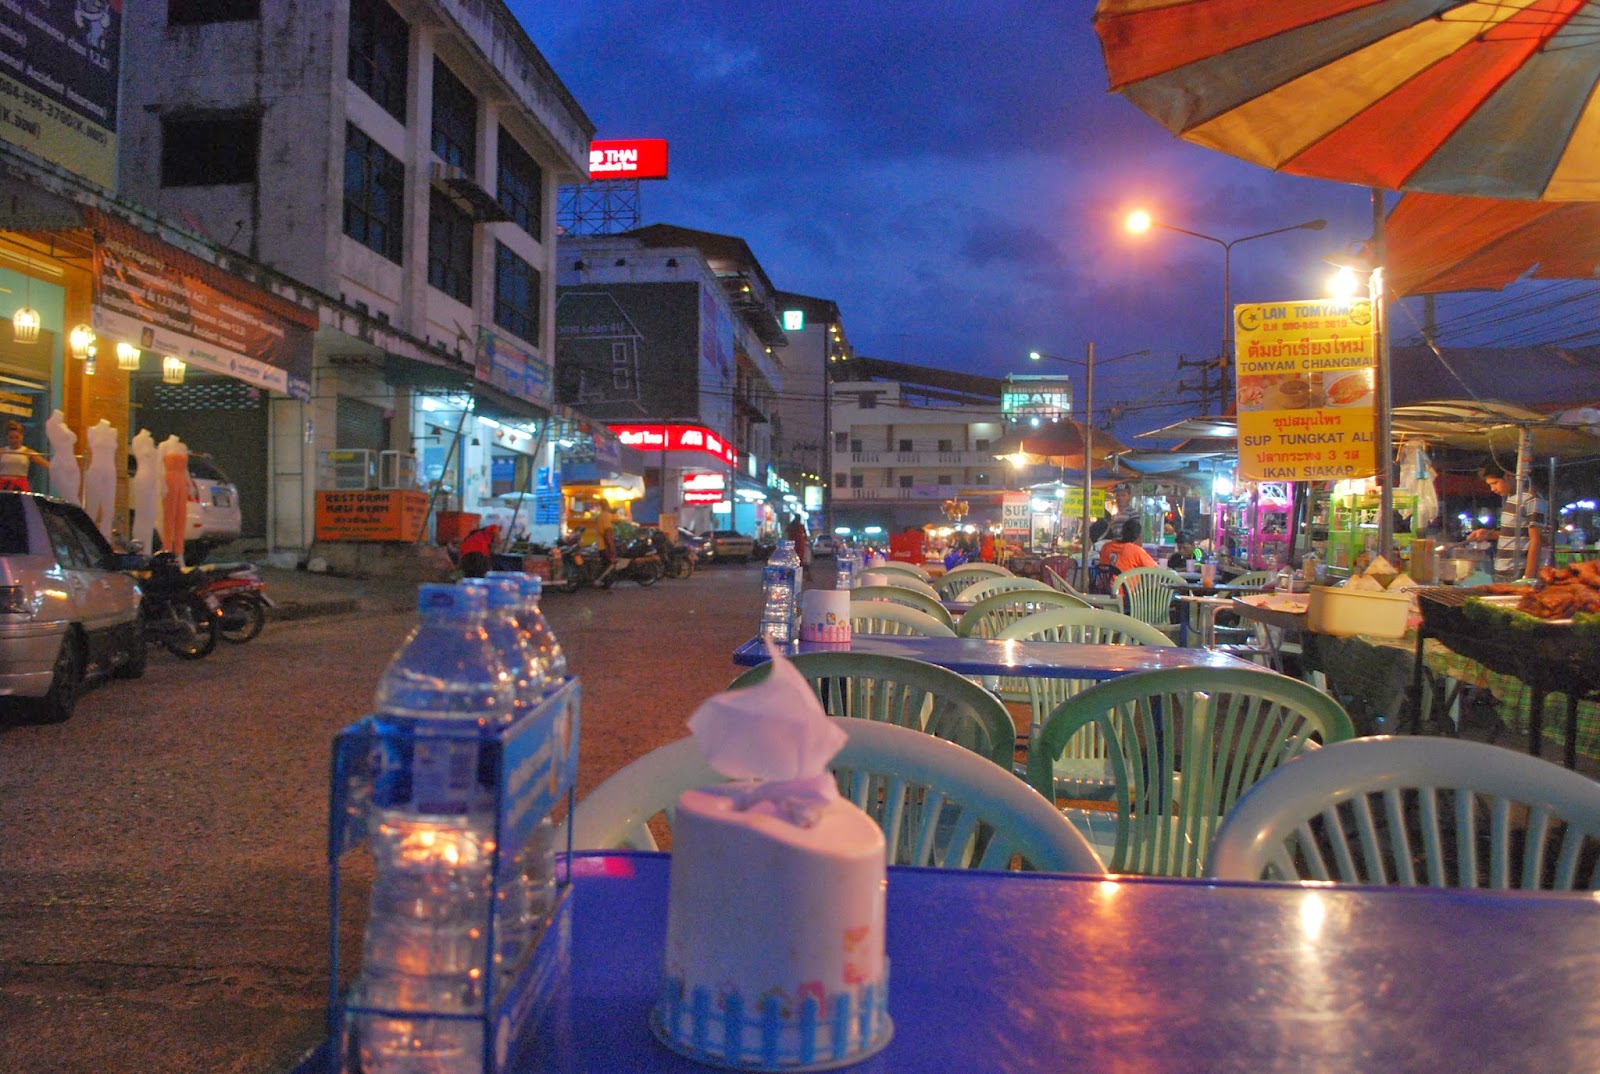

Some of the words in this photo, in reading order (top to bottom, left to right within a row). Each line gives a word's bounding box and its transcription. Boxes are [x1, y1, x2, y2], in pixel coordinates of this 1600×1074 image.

[604, 149, 638, 162] THAI
[1293, 304, 1350, 318] TOMYAM
[1248, 334, 1365, 358] ต้มยำเชียงใหม่
[1240, 360, 1295, 373] TOMYAM
[1243, 434, 1272, 447] SUP
[1278, 431, 1344, 445] TUNGKAT
[1351, 431, 1374, 443] ALI
[1327, 449, 1337, 461] 3
[1263, 466, 1297, 479] IKAN
[1303, 463, 1355, 477] SIAKAP
[1005, 503, 1029, 517] SUP
[1004, 517, 1029, 528] POWER
